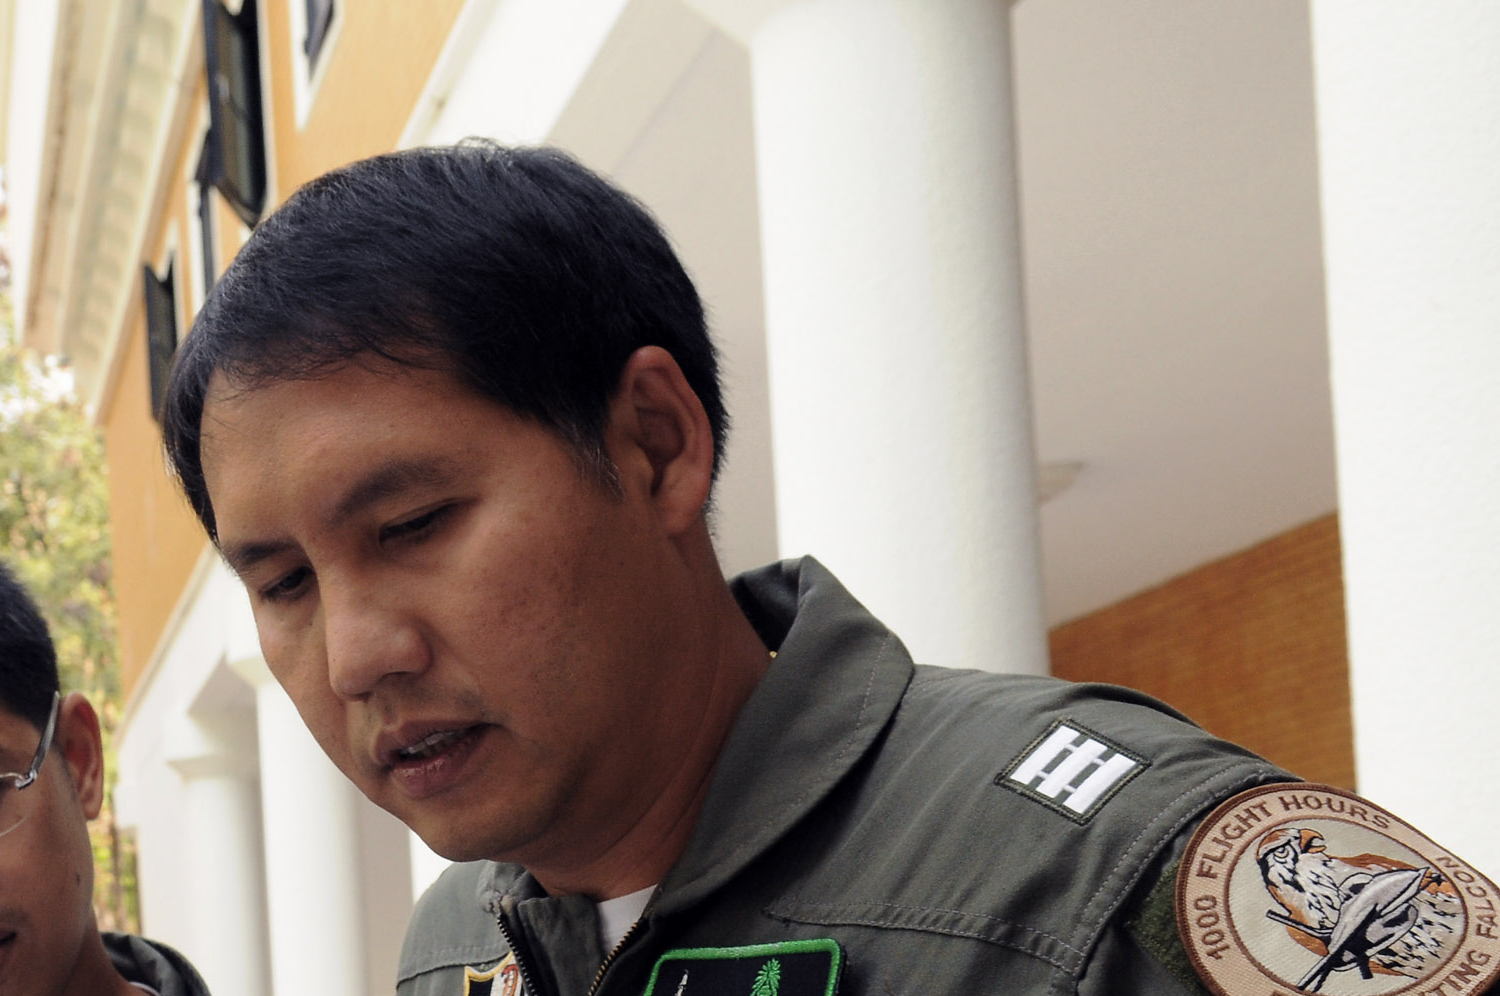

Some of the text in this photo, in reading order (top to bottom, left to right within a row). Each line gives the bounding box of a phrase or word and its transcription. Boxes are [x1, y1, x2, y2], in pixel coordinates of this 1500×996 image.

[1193, 793, 1391, 961] 1000 FLIGHT HOURS
[1436, 855, 1499, 941] FALCON
